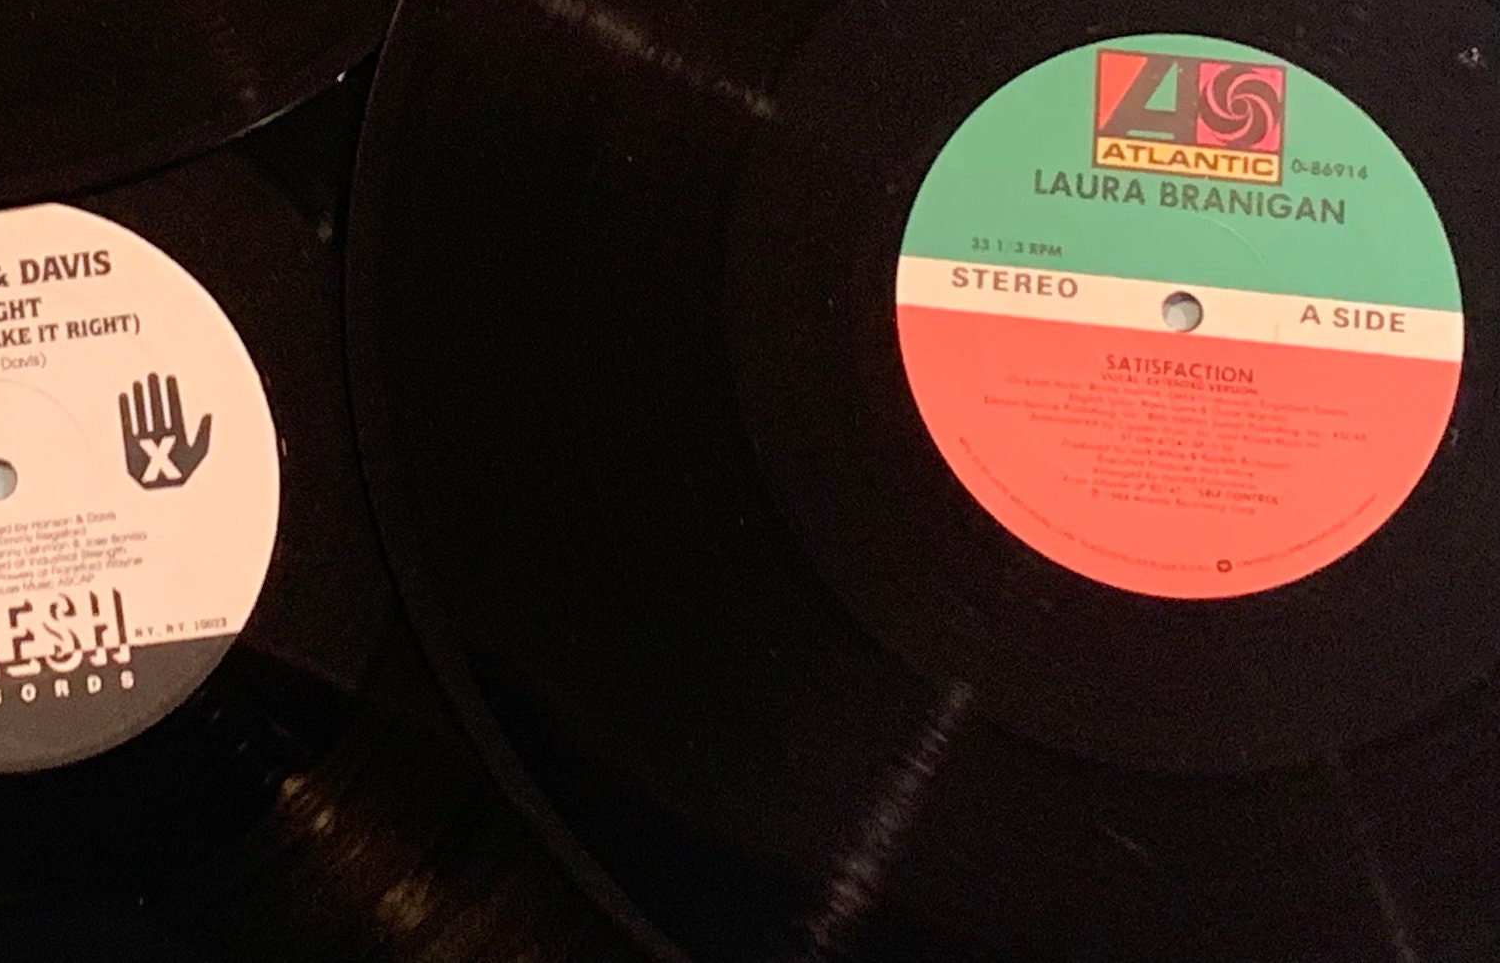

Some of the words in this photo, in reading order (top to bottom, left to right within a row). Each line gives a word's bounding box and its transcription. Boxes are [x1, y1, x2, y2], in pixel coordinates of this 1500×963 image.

[1101, 143, 1276, 179] ATLANTIC
[1033, 168, 1146, 207] LAURA
[1159, 180, 1346, 225] BRANIGAN
[1029, 242, 1062, 257] RPM
[19, 249, 112, 285] DAVIS
[951, 266, 1078, 299] STEREO
[37, 323, 59, 343] IT
[65, 313, 141, 339] RIGHT)
[1300, 304, 1322, 325] A
[1332, 306, 1407, 334] SIDE
[0, 351, 47, 374] Davis)
[1106, 353, 1254, 384] SATISFACTION
[137, 434, 183, 485] X
